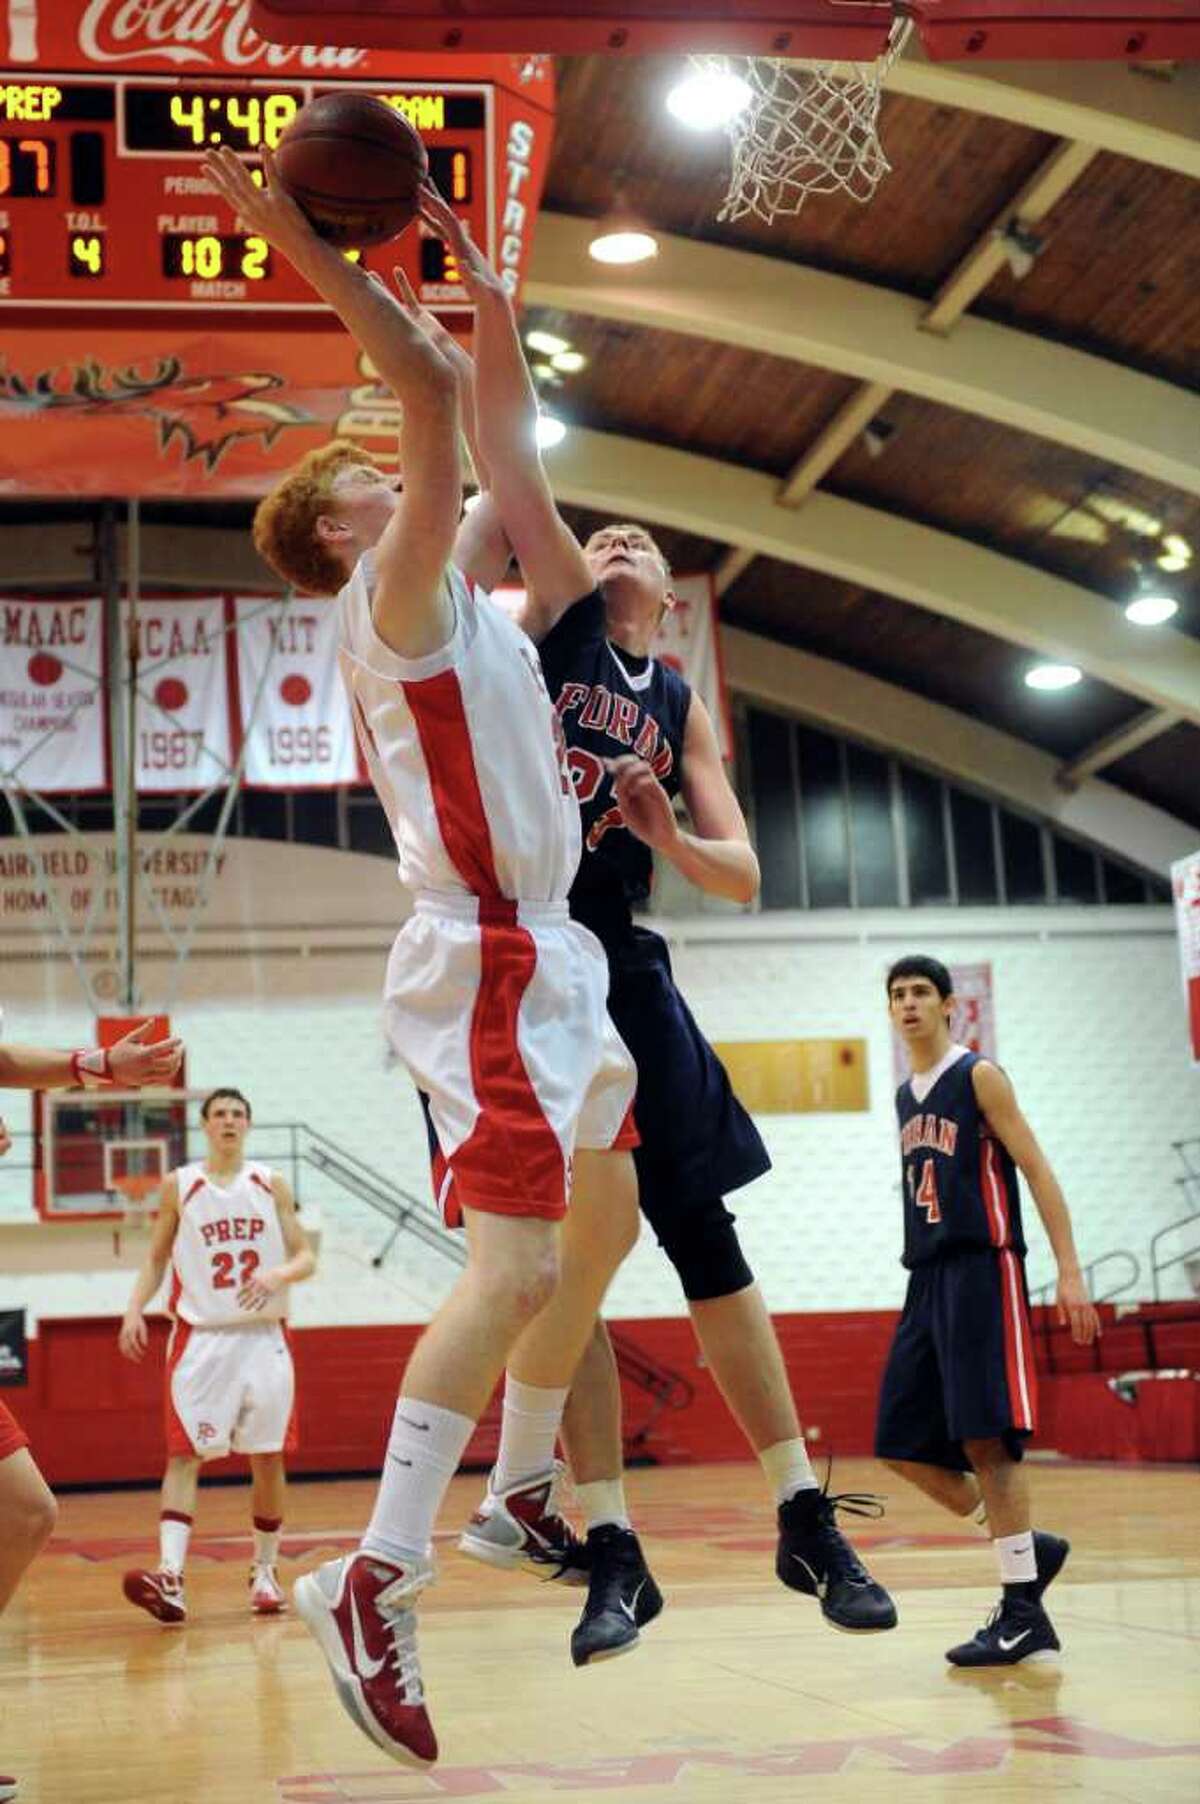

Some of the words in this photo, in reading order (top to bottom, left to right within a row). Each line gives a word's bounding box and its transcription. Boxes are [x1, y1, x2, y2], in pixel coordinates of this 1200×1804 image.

[377, 94, 445, 130] RAN
[73, 237, 101, 273] 4
[182, 236, 222, 279] 10
[242, 237, 269, 280] 2
[4, 606, 86, 646] MAAC
[141, 730, 205, 769] 1987
[267, 725, 331, 765] 1996
[0, 851, 88, 876] AIRIELD
[105, 848, 225, 878] UVERSIY
[3, 888, 53, 912] HOM
[201, 1217, 264, 1246] PREP
[212, 1250, 260, 1289] 22
